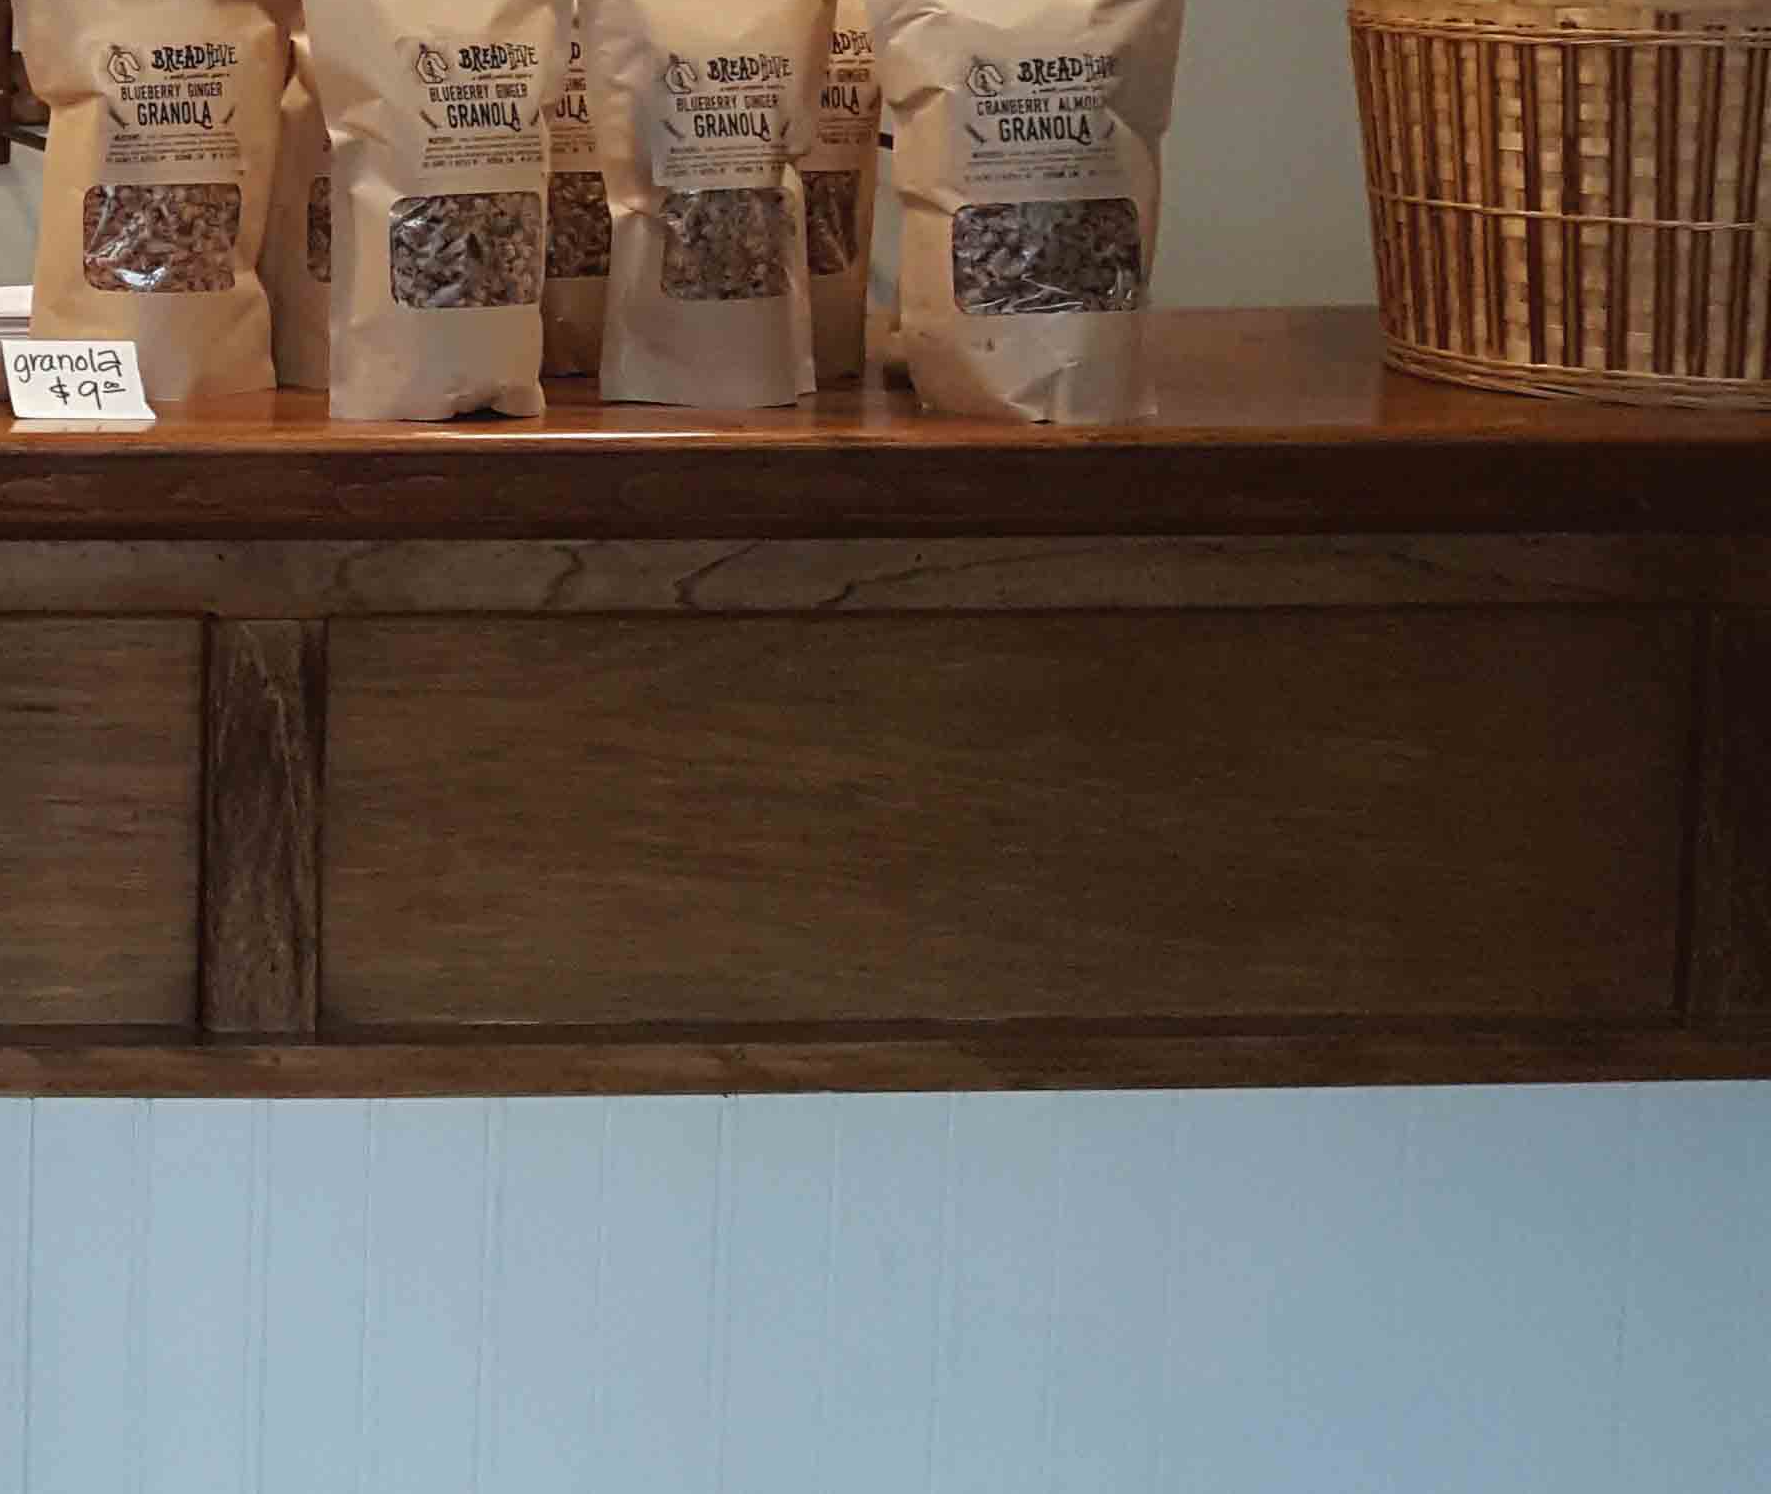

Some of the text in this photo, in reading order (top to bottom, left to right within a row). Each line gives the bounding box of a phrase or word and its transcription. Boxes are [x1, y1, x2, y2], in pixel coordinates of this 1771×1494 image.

[120, 81, 223, 101] BLUEBERRY GINGER
[428, 83, 489, 103] BLUEBERRY
[675, 93, 739, 113] BLUEBERRY
[820, 86, 860, 116] NOLA
[137, 99, 214, 130] GRANOLA
[447, 100, 522, 132] GRANOLA
[976, 96, 1050, 117] CRANBERRY
[693, 112, 773, 143] GRANOLA
[999, 113, 1092, 146] GRANOLA
[13, 347, 123, 384] granola
